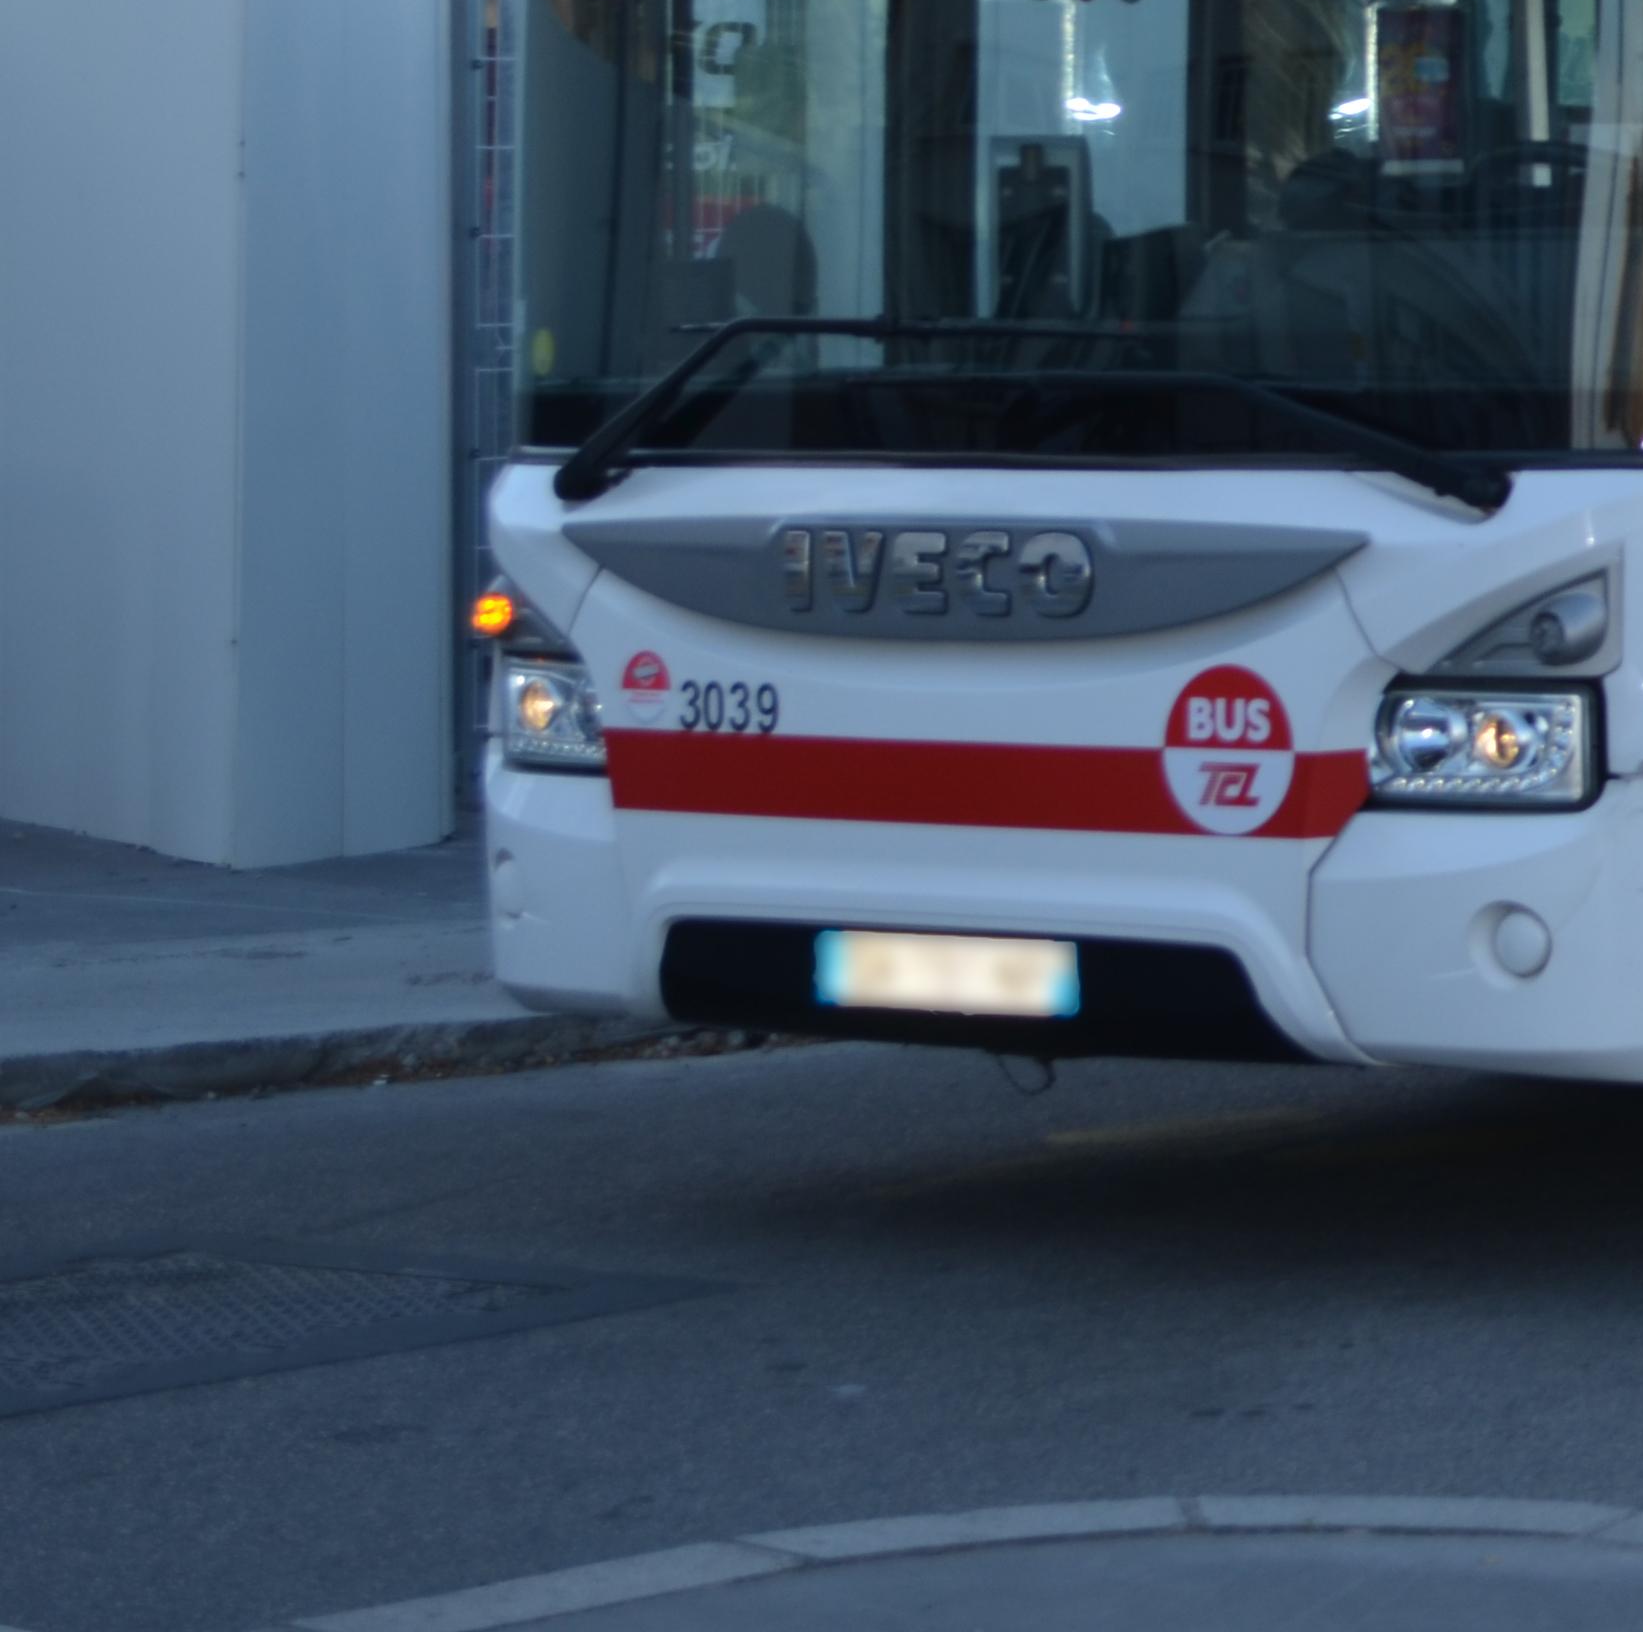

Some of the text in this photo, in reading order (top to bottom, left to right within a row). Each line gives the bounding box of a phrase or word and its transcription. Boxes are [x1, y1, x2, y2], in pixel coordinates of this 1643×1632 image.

[784, 529, 1095, 619] IVECO
[680, 680, 779, 734] 3039
[1187, 696, 1272, 744] BUS
